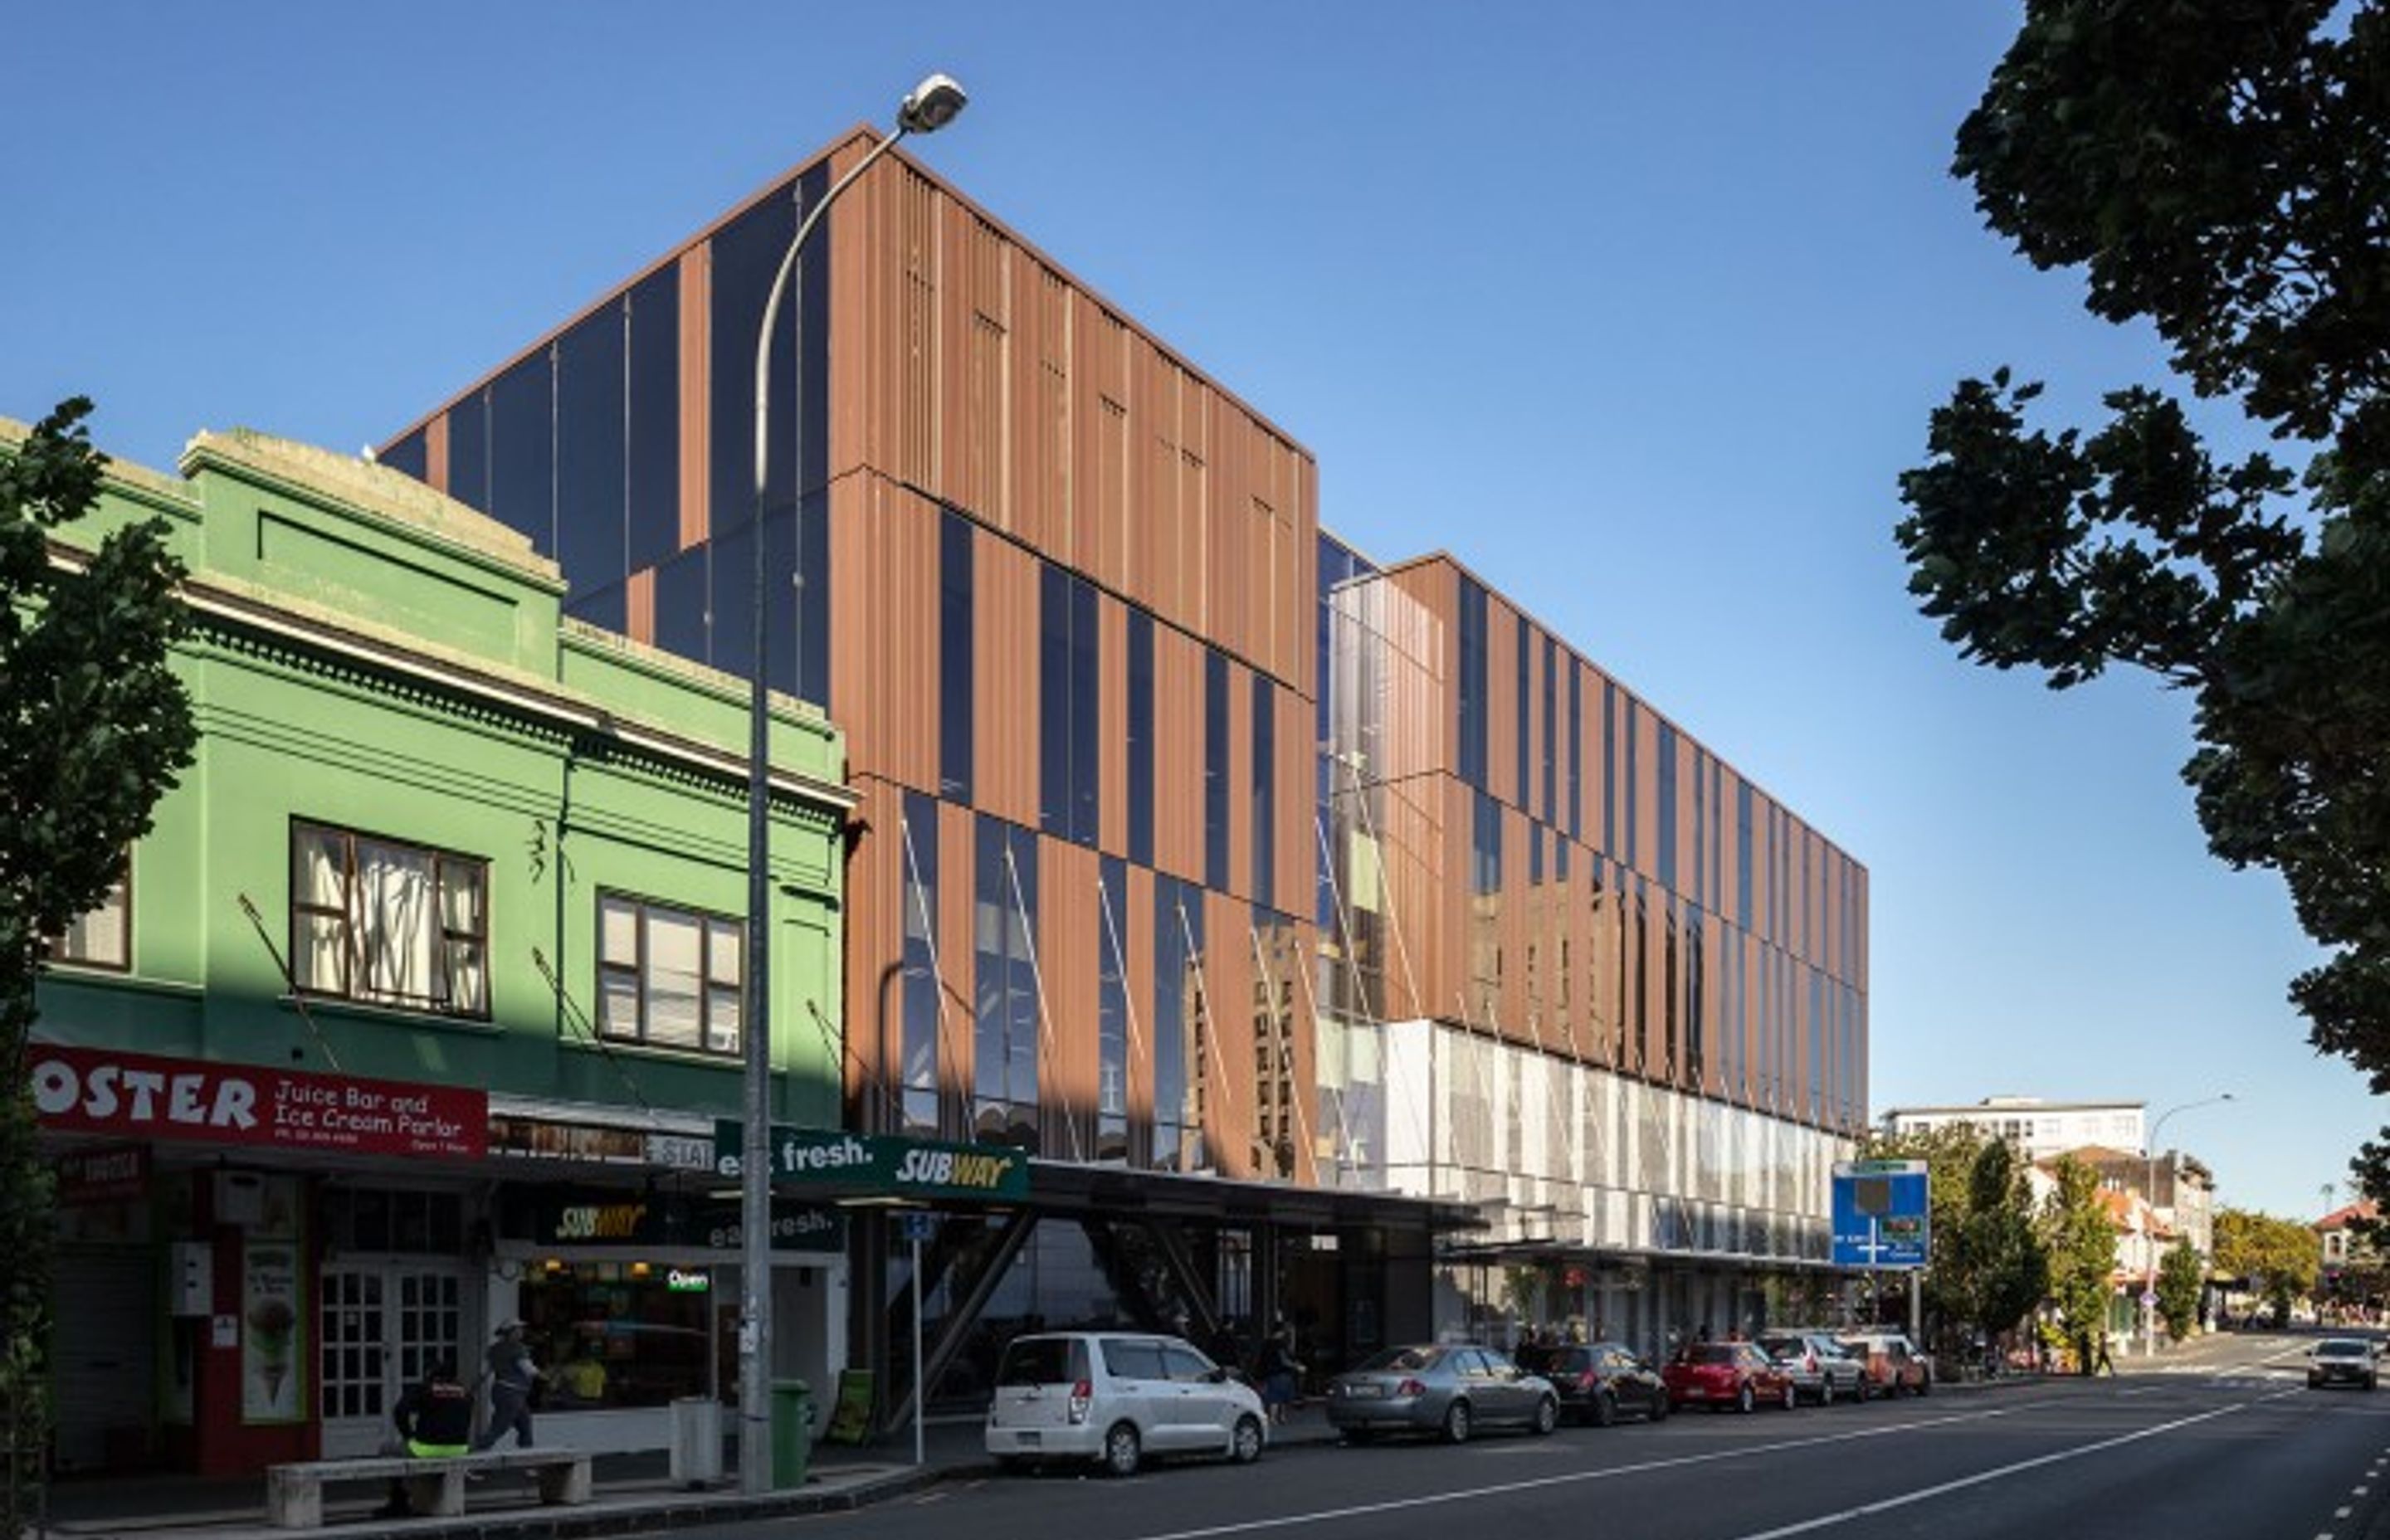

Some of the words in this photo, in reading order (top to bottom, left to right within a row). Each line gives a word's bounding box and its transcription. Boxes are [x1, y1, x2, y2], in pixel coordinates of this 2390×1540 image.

[275, 1080, 338, 1105] Juice
[346, 1087, 385, 1109] Bar
[391, 1095, 428, 1114] and
[274, 1104, 314, 1127] Ice
[322, 1108, 393, 1133] Cream
[783, 1136, 874, 1172] fresh.
[895, 1148, 1014, 1188] SUBWAY
[556, 1204, 646, 1240] SUBWAY
[708, 1224, 743, 1247] ea
[771, 1207, 833, 1236] resh.
[667, 1269, 710, 1289] Open
